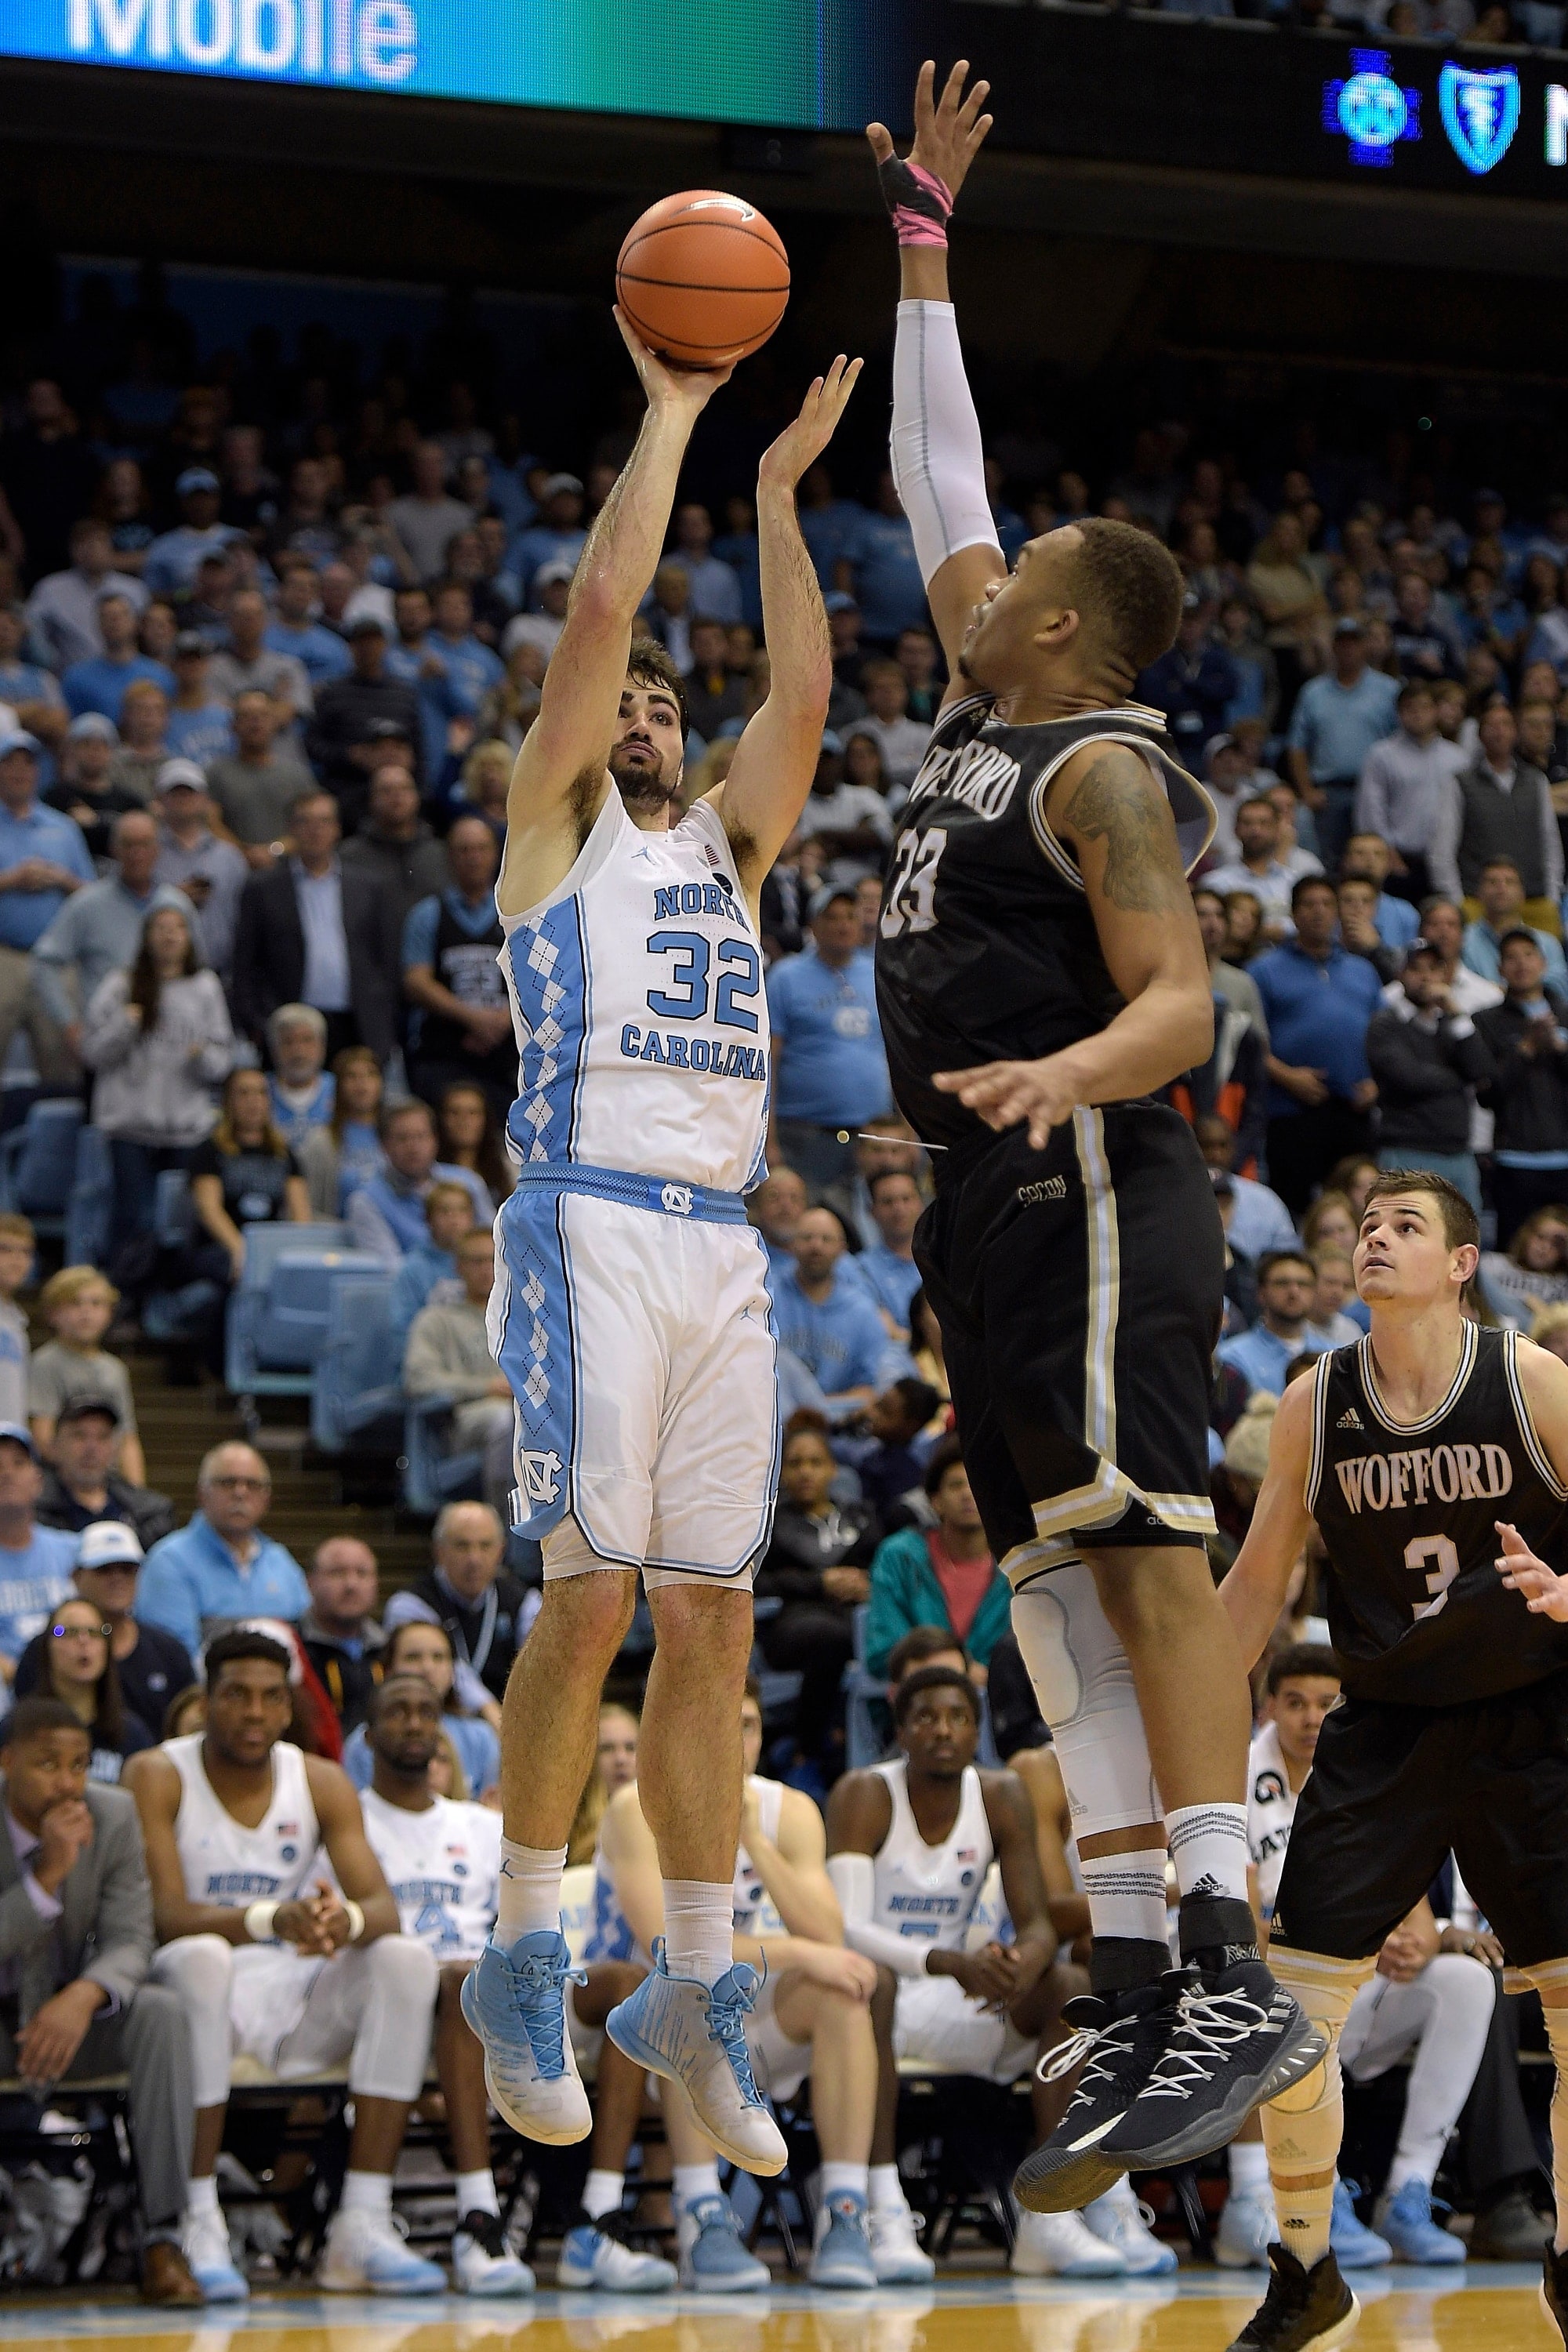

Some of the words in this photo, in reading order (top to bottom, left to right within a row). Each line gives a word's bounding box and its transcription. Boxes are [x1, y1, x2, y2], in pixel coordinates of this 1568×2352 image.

[907, 739, 1022, 820] OFFORD
[881, 828, 947, 938] 33
[646, 931, 759, 1034] 32
[620, 1024, 766, 1080] CAROLINA
[1336, 1421, 1365, 1430] adidas
[1334, 1443, 1513, 1515] WOFFORD
[1403, 1534, 1461, 1621] 3
